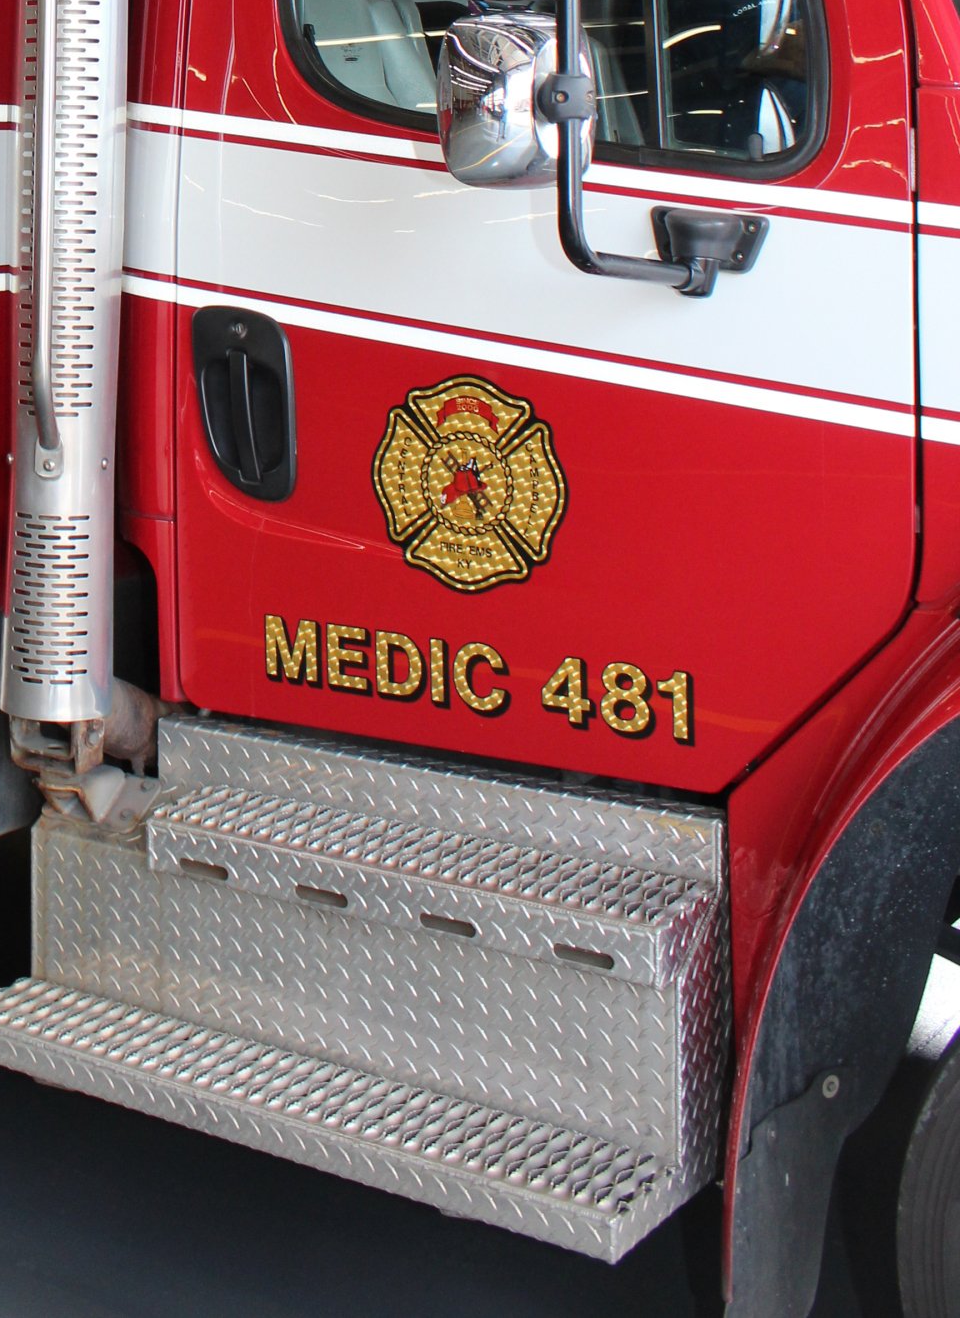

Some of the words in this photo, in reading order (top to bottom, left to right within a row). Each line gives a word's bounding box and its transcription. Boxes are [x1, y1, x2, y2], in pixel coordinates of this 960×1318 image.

[732, 2, 758, 17] LOCAL
[397, 436, 412, 517] CENTRAL
[523, 442, 540, 539] CAMPBELL
[440, 541, 463, 554] FIRE
[469, 545, 493, 558] EMS
[457, 558, 472, 569] KY
[264, 613, 512, 719] MEDIC
[541, 656, 695, 747] 481
